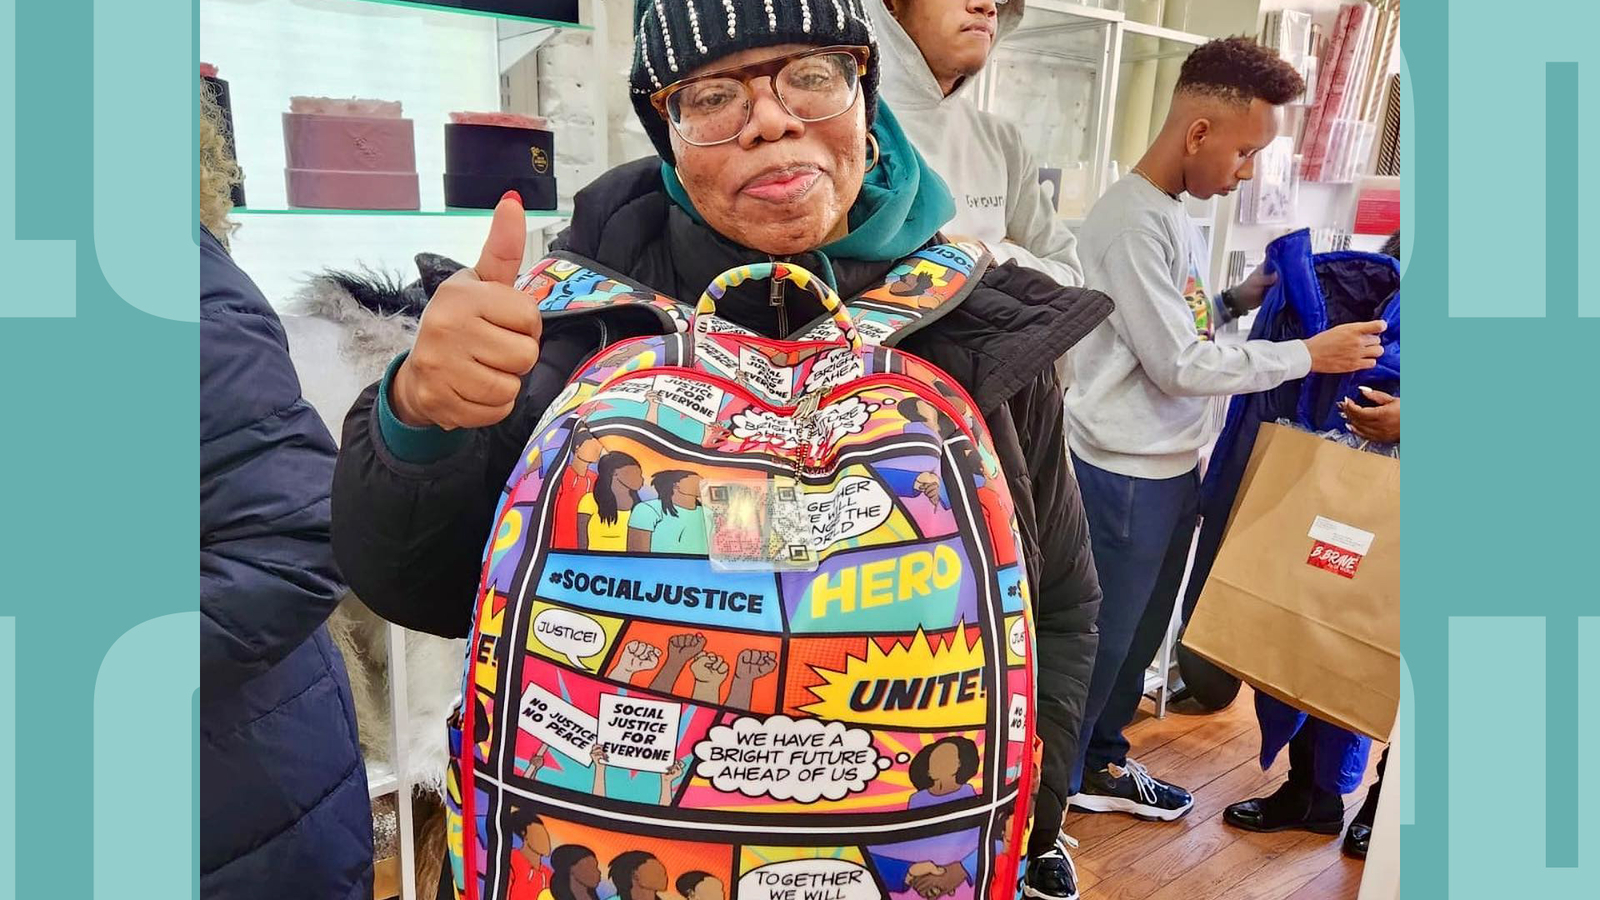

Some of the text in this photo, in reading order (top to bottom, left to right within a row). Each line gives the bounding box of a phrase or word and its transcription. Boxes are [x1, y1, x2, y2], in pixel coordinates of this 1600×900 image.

[664, 378, 715, 399] JUSTICE
[675, 387, 705, 403] FOR
[656, 389, 715, 418] EVERYONE
[845, 504, 881, 520] THE
[549, 568, 763, 614] #SOCIALJUSTICE
[810, 544, 963, 620] HERO
[537, 620, 597, 644] JUSTICE!
[849, 667, 986, 713] UNITE!
[528, 697, 599, 743] NO JUSTICE
[613, 702, 664, 720] SOCIAL
[521, 706, 590, 751] NO PEACE
[607, 716, 668, 734] JUSTICE
[621, 731, 657, 746] FOR
[736, 731, 844, 748] WE HAVE A
[602, 742, 671, 762] EVERYONE
[709, 747, 869, 766] BRIGHT FUTURE
[717, 766, 859, 782] AHEAD OF US
[754, 868, 864, 888] TOGETHER
[769, 887, 848, 900] WE WILL
